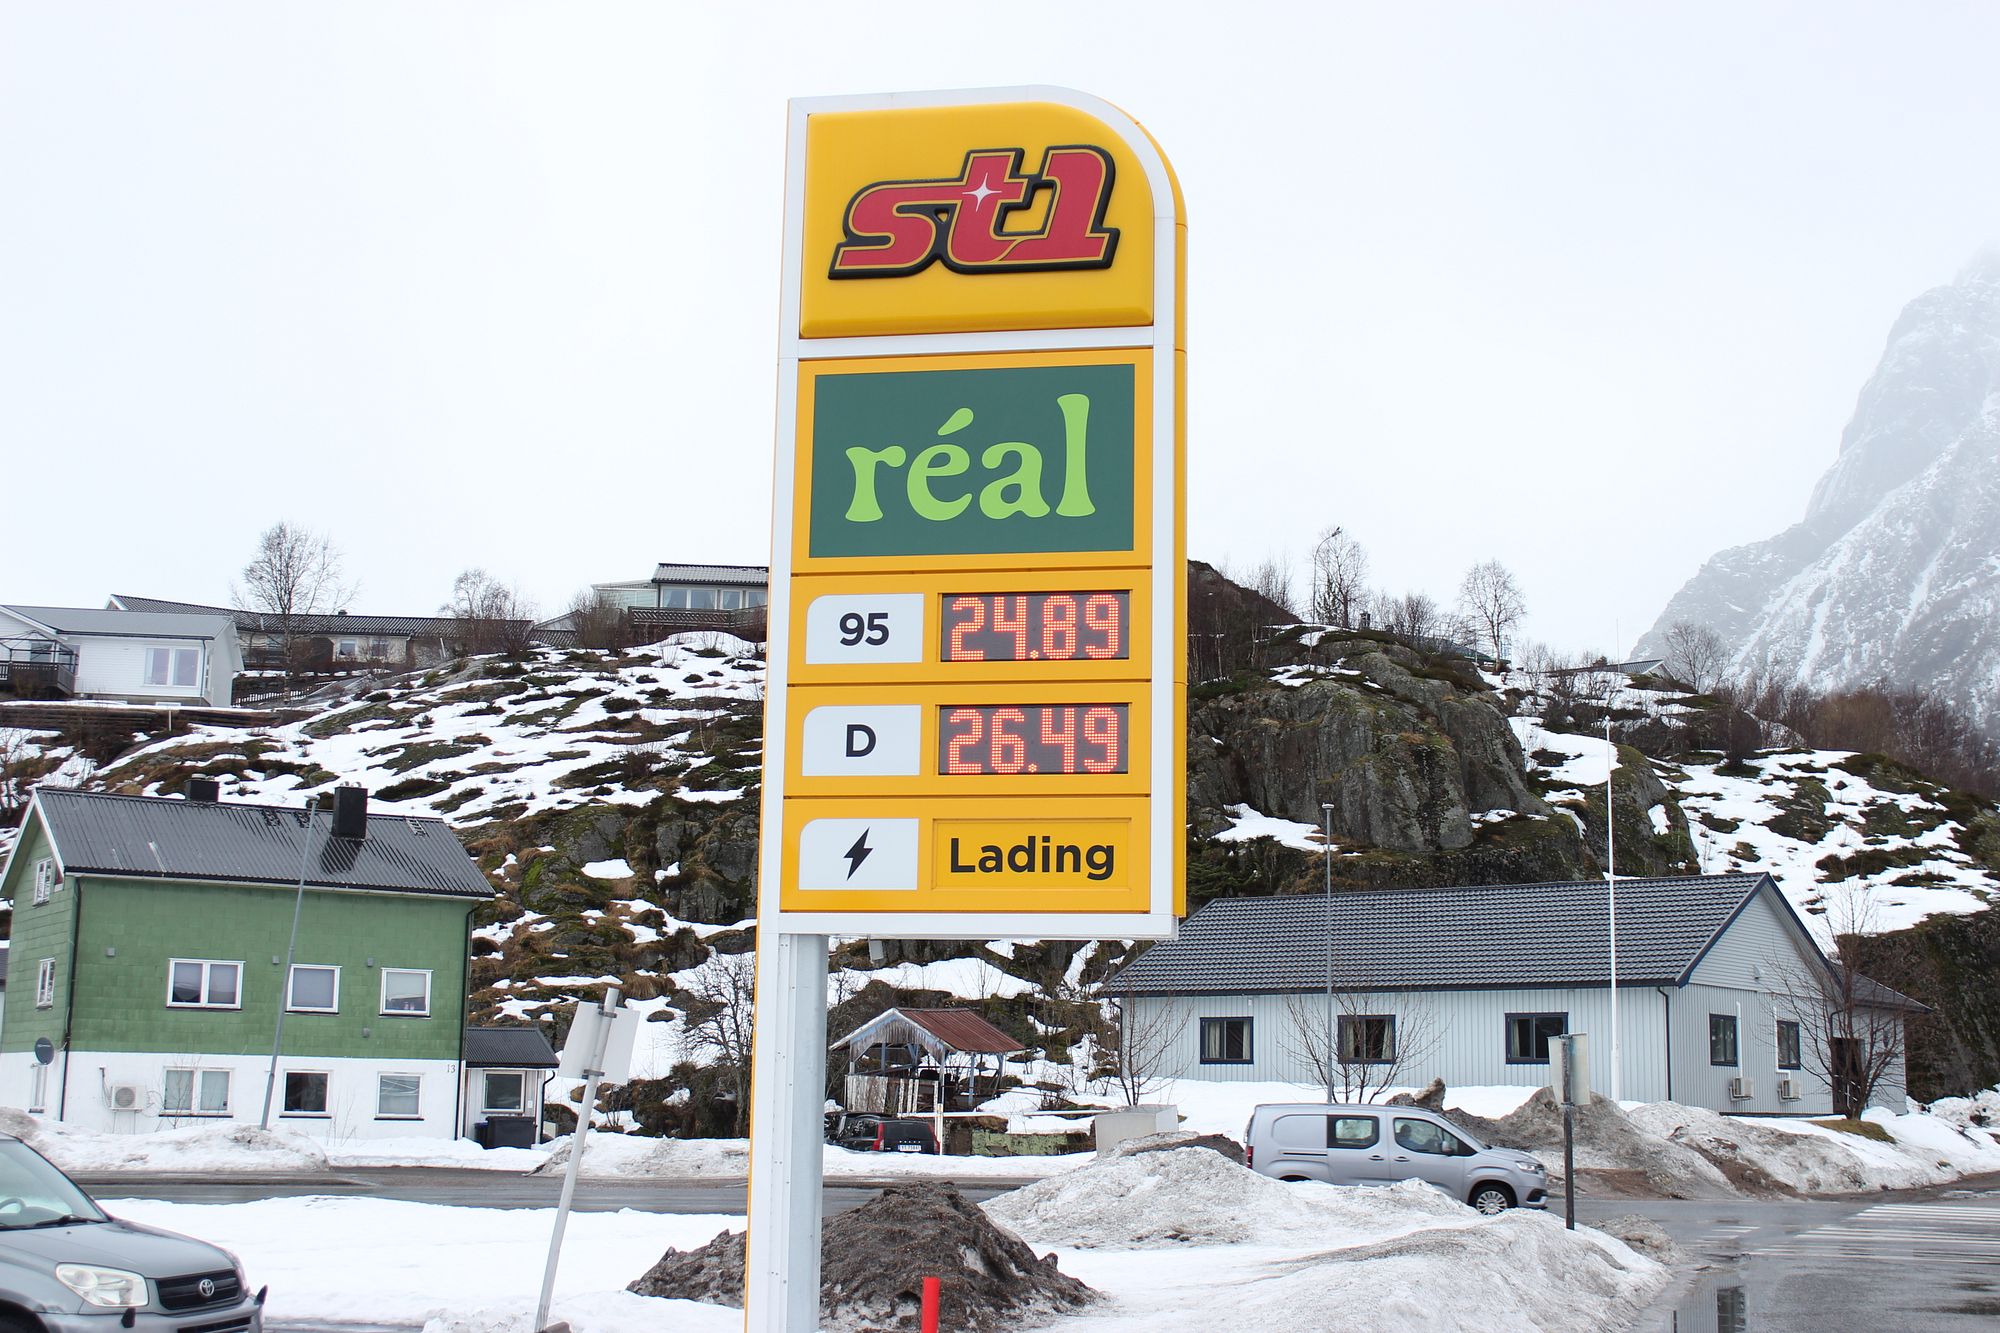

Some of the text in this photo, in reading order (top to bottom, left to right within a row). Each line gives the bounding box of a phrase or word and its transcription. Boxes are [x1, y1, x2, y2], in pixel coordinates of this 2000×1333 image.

[828, 145, 1120, 279] st1
[845, 394, 1095, 522] réal
[839, 612, 889, 646] 95
[951, 594, 1119, 661] 24.89
[845, 724, 877, 758] D
[948, 707, 1118, 774] 26.49
[950, 836, 1115, 881] Lading
[446, 1064, 456, 1073] 13
